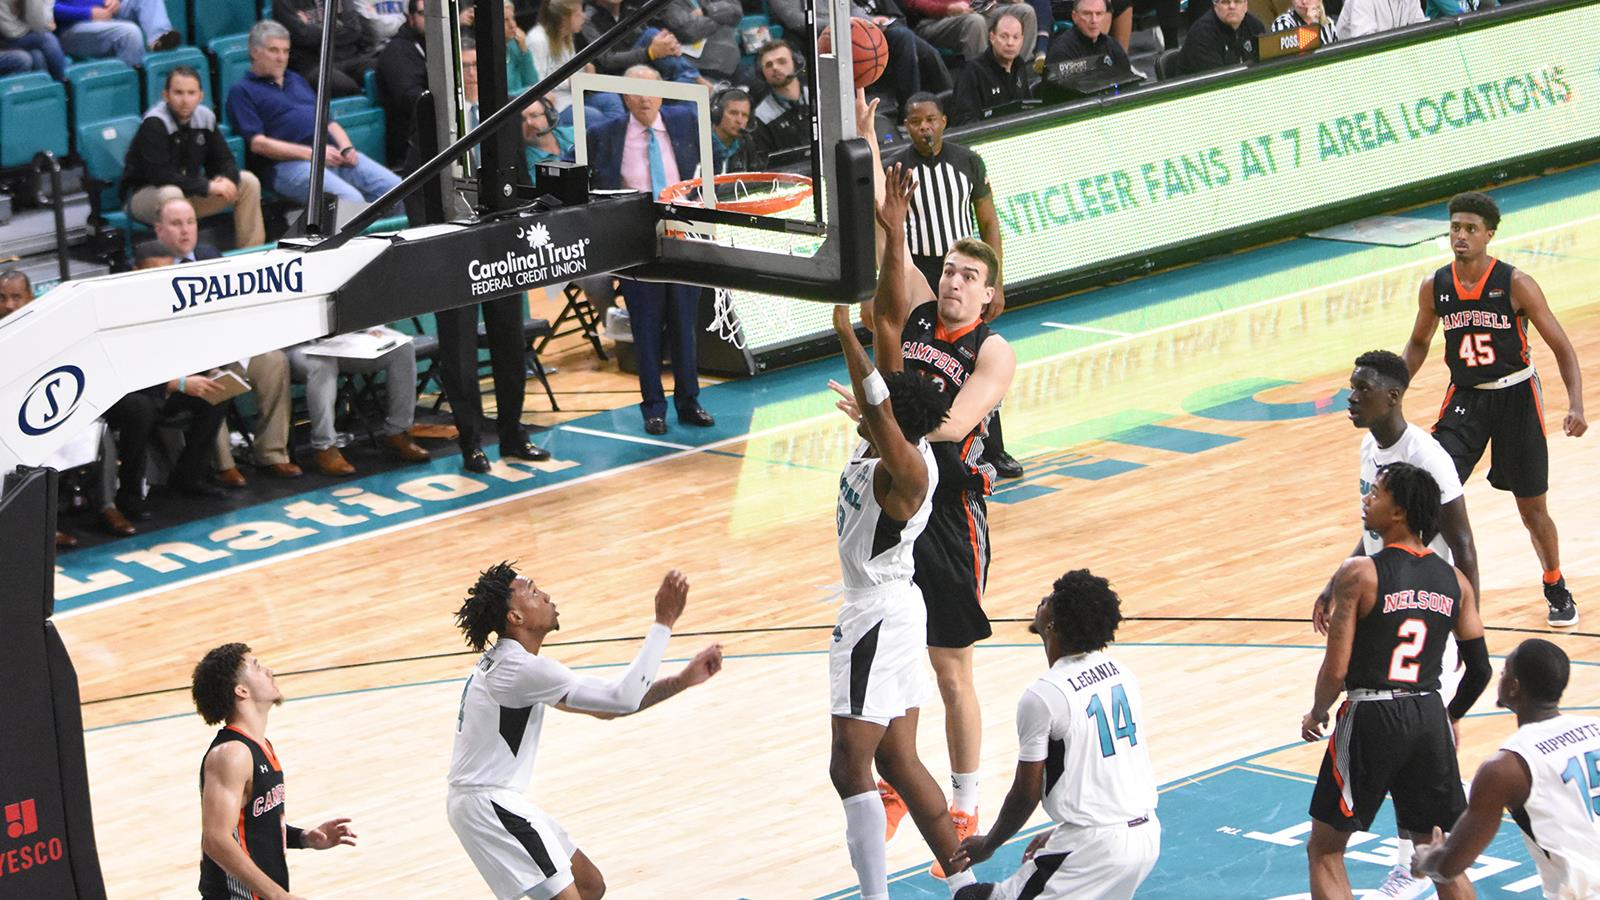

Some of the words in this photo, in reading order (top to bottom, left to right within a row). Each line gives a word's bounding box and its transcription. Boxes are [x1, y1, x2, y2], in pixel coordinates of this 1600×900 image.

[994, 169, 1138, 236] NTICLEER
[1140, 147, 1231, 201] FANS
[1240, 134, 1278, 181] AT
[1281, 128, 1301, 168] 7
[1317, 107, 1398, 161] AREA
[1401, 65, 1571, 140] LOCATIONS
[469, 251, 537, 281] Carolina
[472, 276, 513, 295] FEDERAL
[516, 267, 548, 285] CREDIT
[551, 259, 587, 278] UNION
[172, 257, 303, 313] SPALDING
[1441, 311, 1511, 331] AMPBELL
[1459, 333, 1496, 367] 45
[1383, 590, 1453, 617] NELSON
[1388, 618, 1427, 683] 2
[1086, 683, 1138, 758] 14
